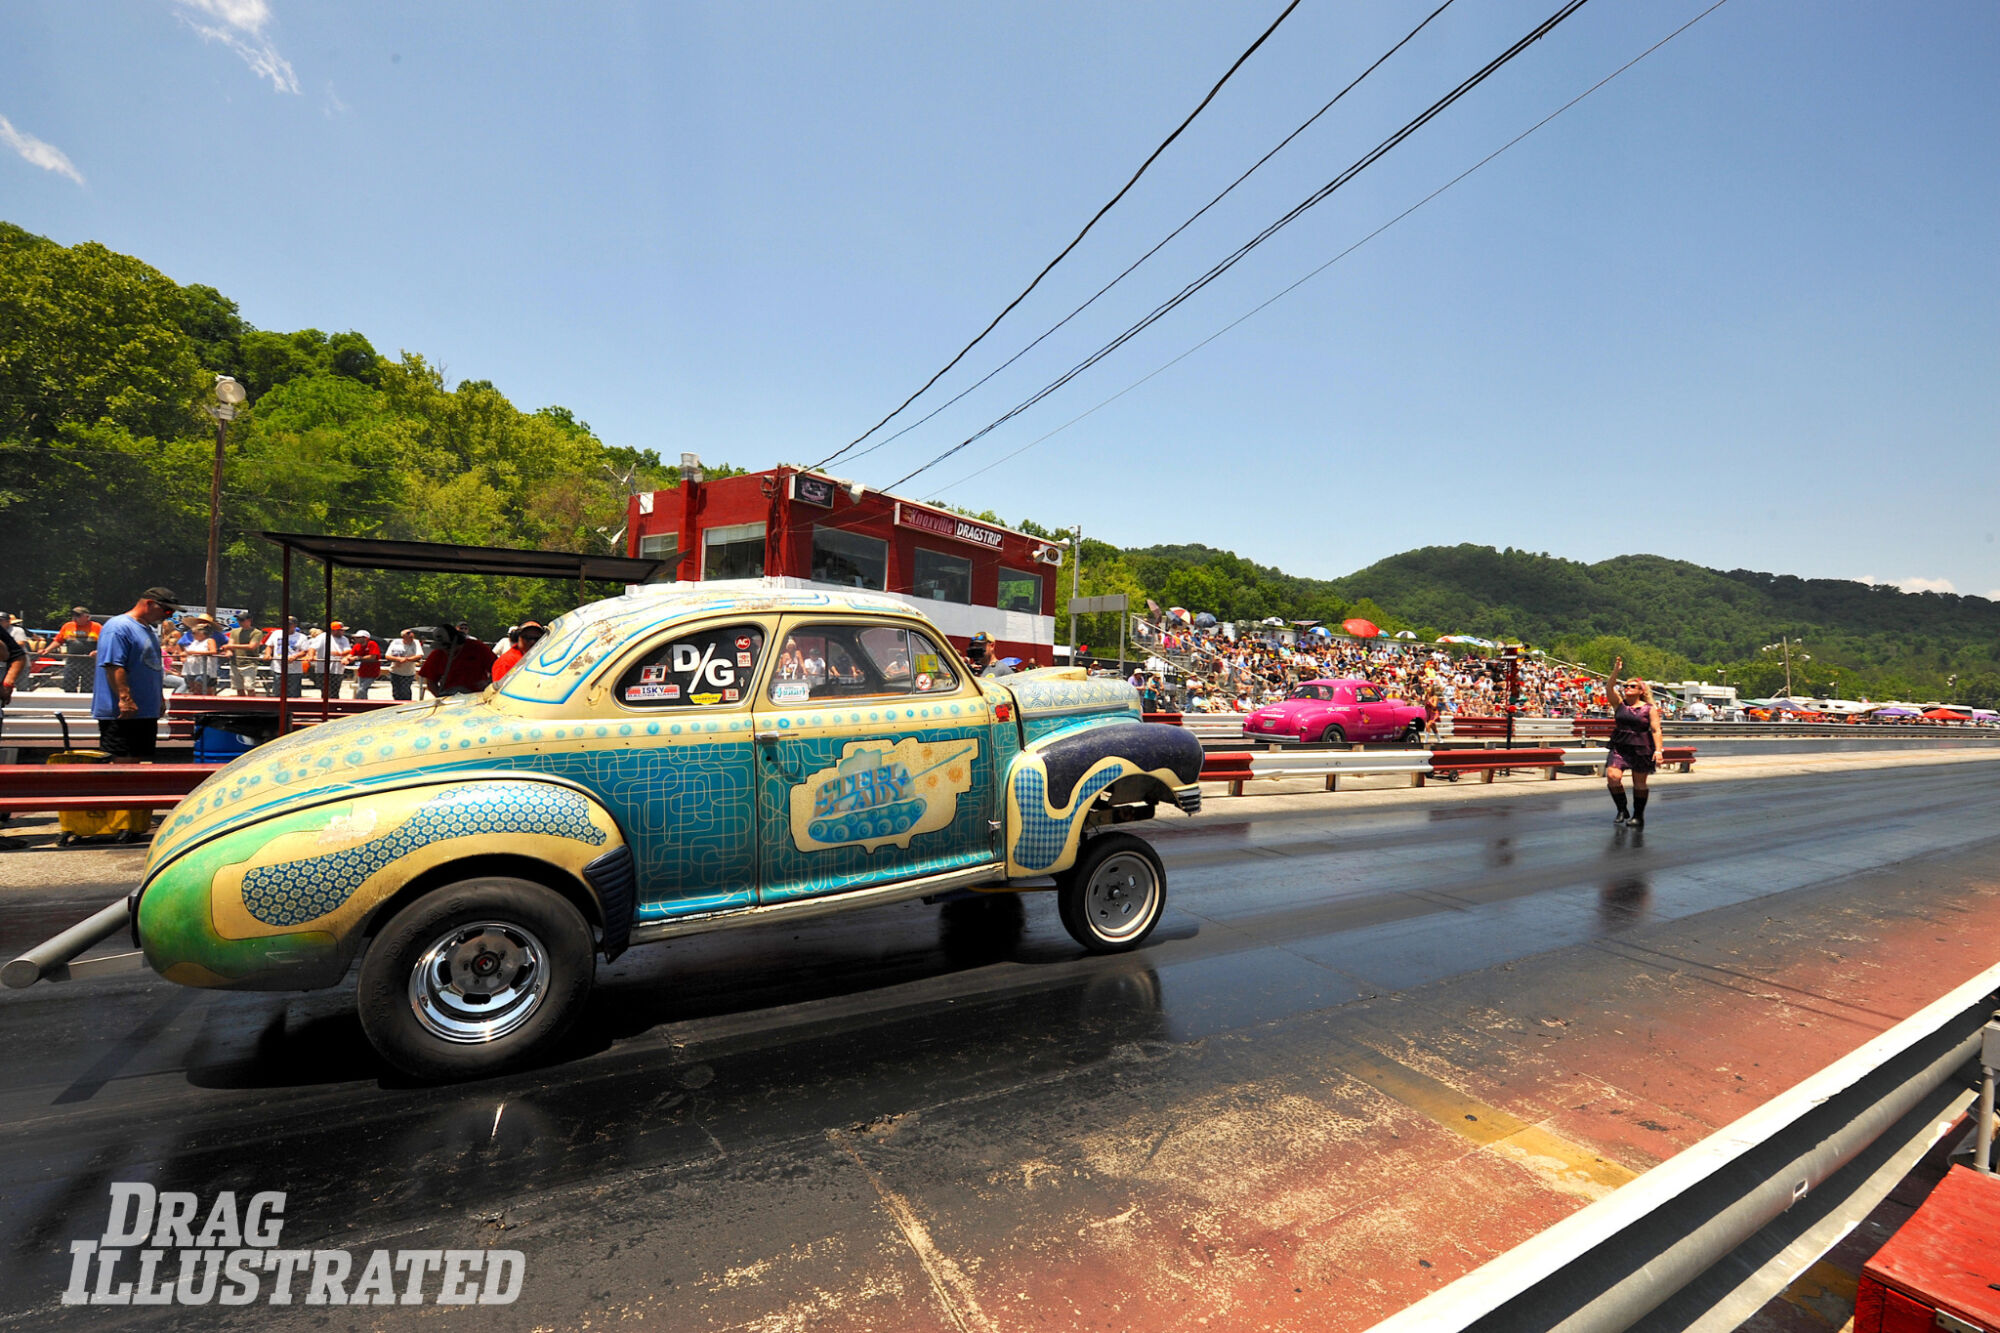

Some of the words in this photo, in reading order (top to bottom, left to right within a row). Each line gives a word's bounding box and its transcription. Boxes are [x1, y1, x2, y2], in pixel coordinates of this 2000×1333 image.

[908, 509, 953, 533] Knoxville
[956, 522, 1002, 546] DRAGSTRIP
[673, 643, 735, 693] D/G
[642, 686, 664, 694] ISKY
[814, 764, 912, 817] STEEL
[832, 780, 906, 813] LADY
